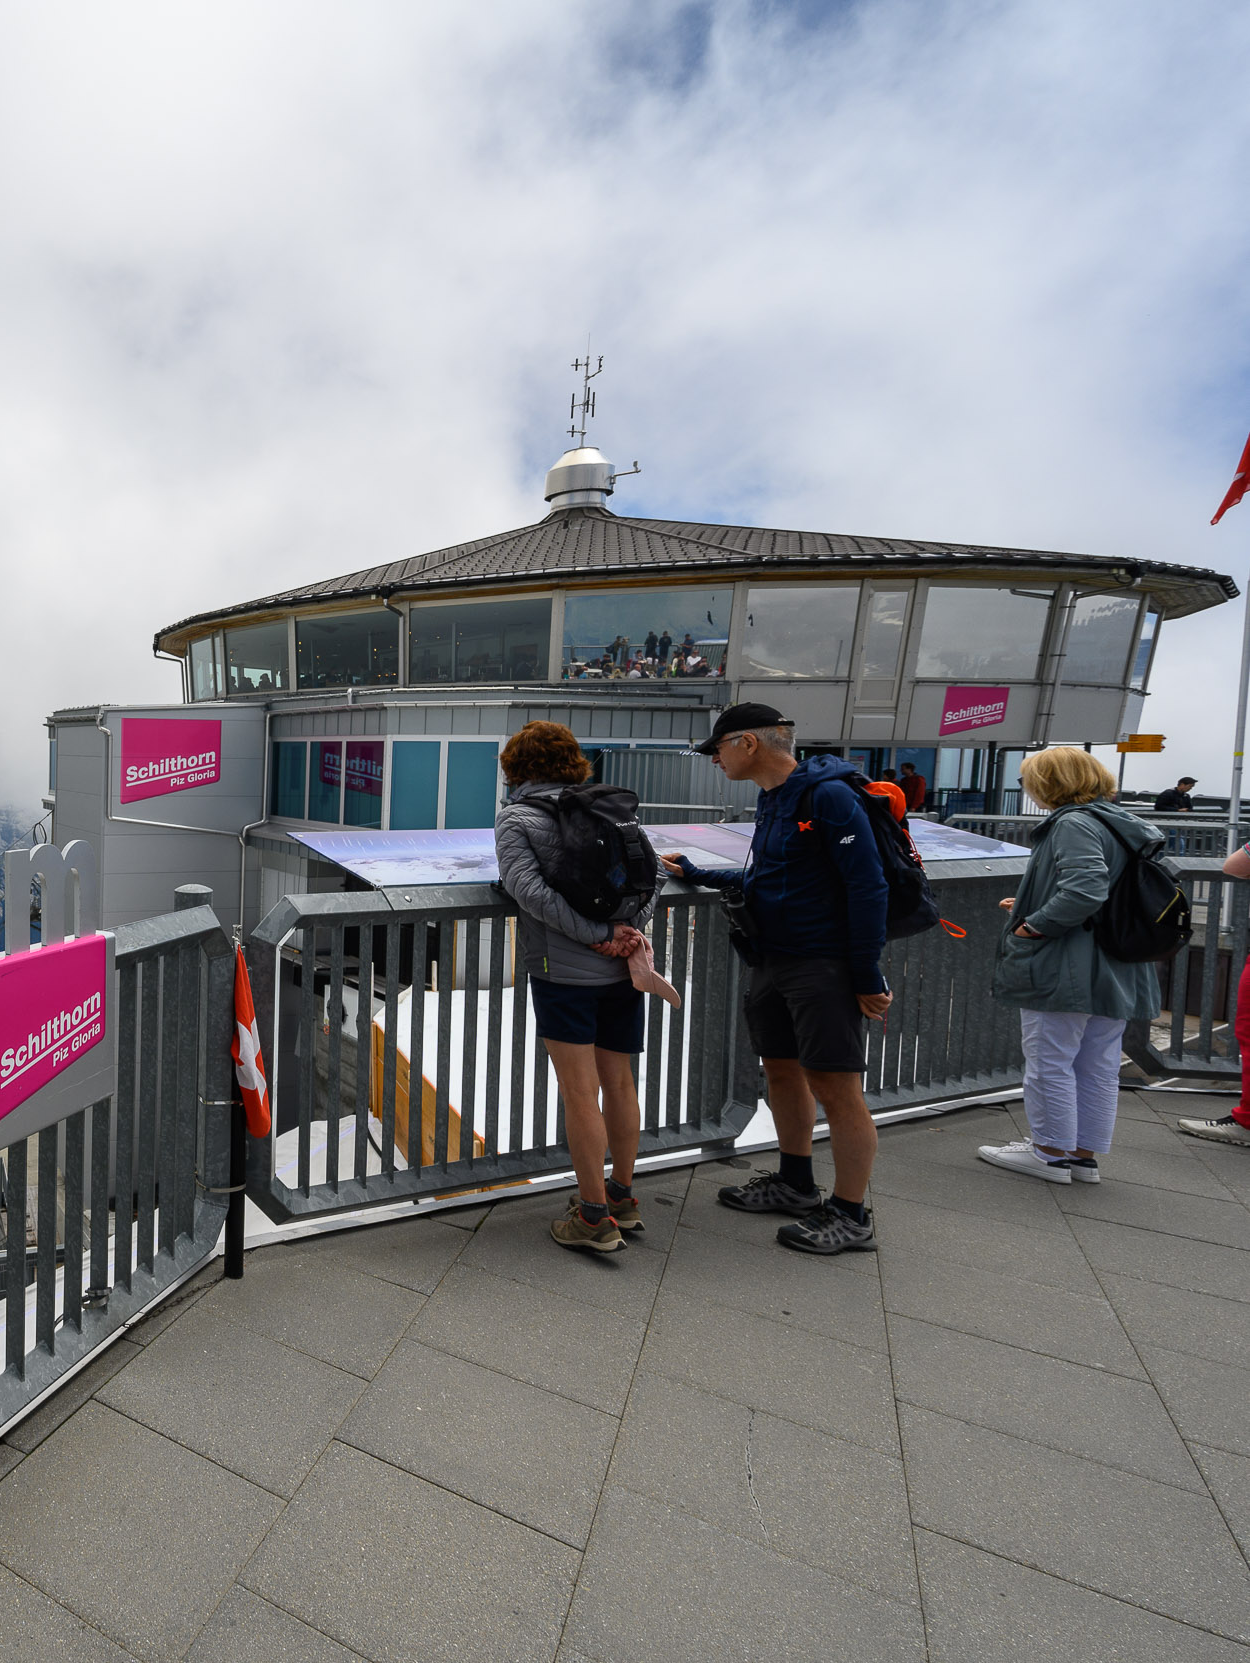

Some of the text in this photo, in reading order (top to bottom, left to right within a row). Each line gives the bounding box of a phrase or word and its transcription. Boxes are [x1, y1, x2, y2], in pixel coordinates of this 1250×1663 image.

[944, 702, 1004, 721] Schilthorn
[982, 714, 1002, 723] Gloria
[126, 751, 216, 782] Schilthorn
[170, 770, 215, 787] Piz Gloria
[5, 839, 100, 956] m
[0, 991, 101, 1078] Schilthorn
[52, 1022, 101, 1068] Piz Gloria
